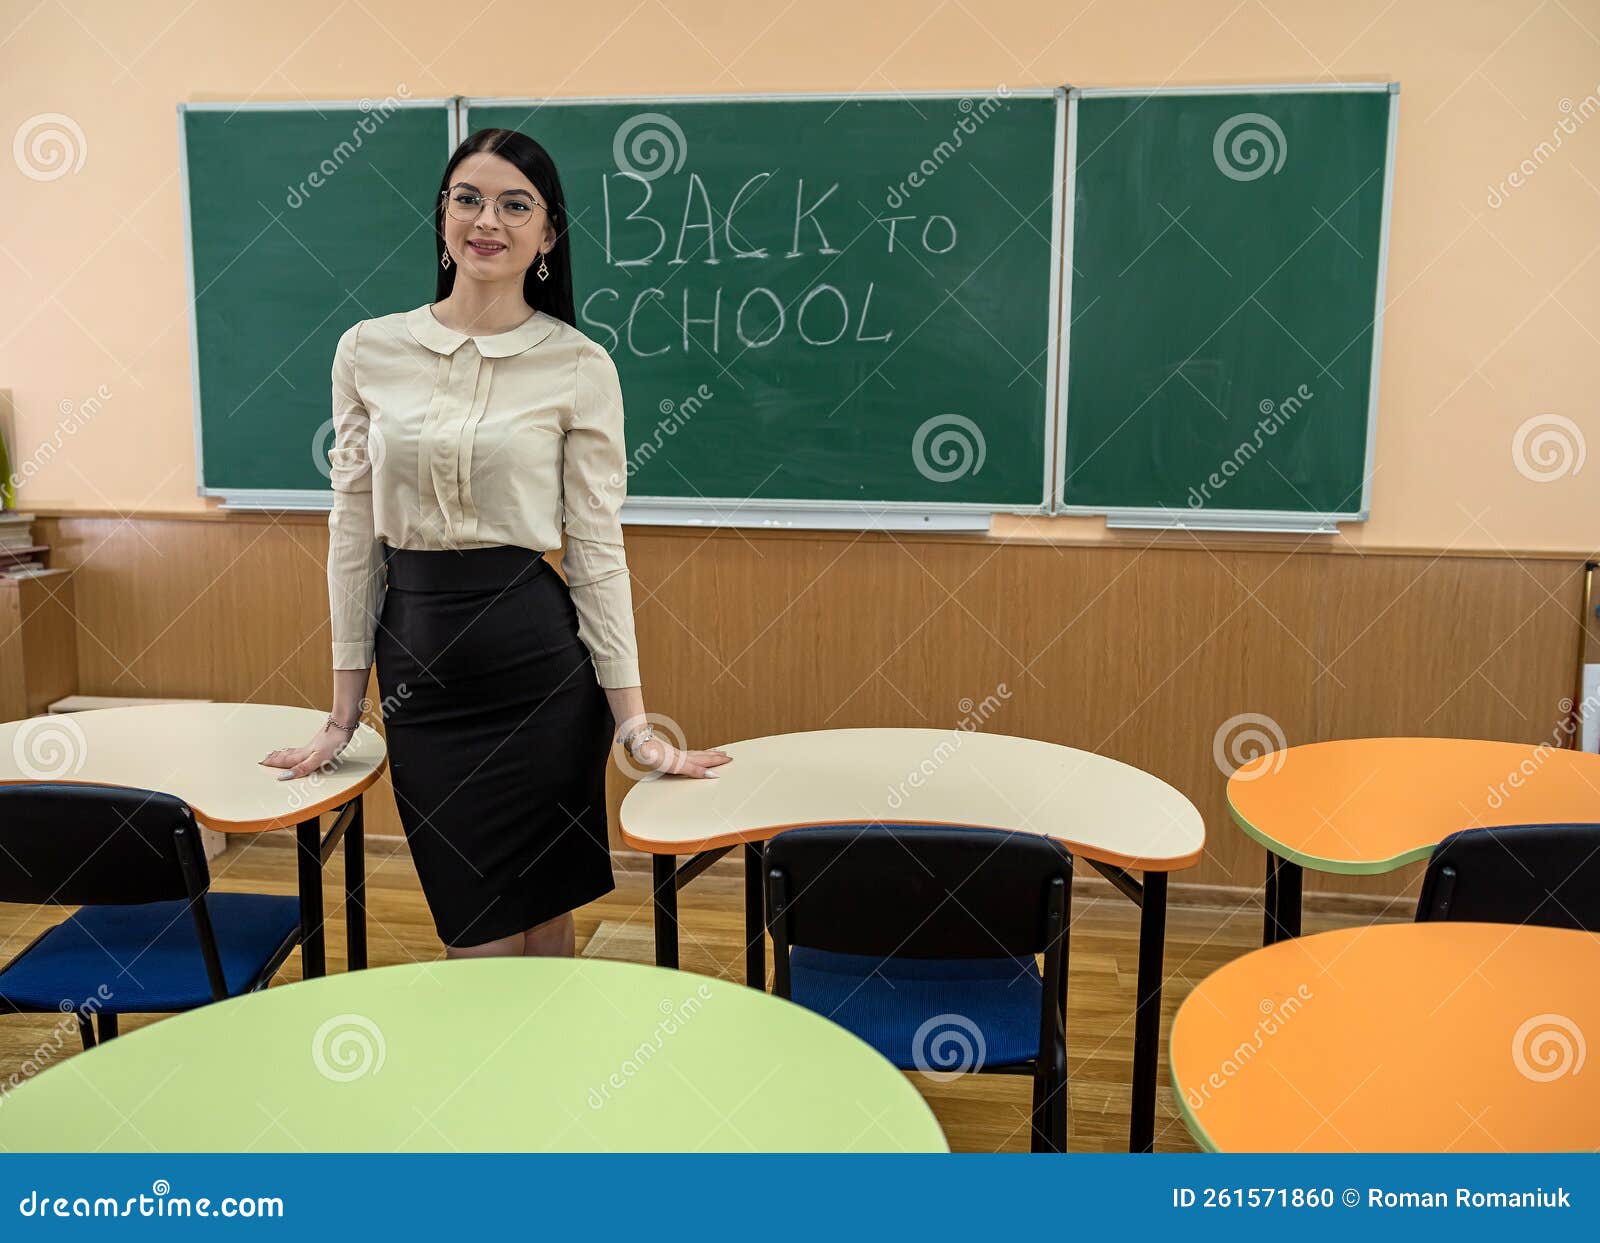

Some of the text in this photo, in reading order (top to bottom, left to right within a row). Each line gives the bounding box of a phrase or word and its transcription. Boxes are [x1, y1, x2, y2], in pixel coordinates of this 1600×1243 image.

[602, 172, 957, 266] BACK TO
[581, 282, 894, 357] SCHOOL
